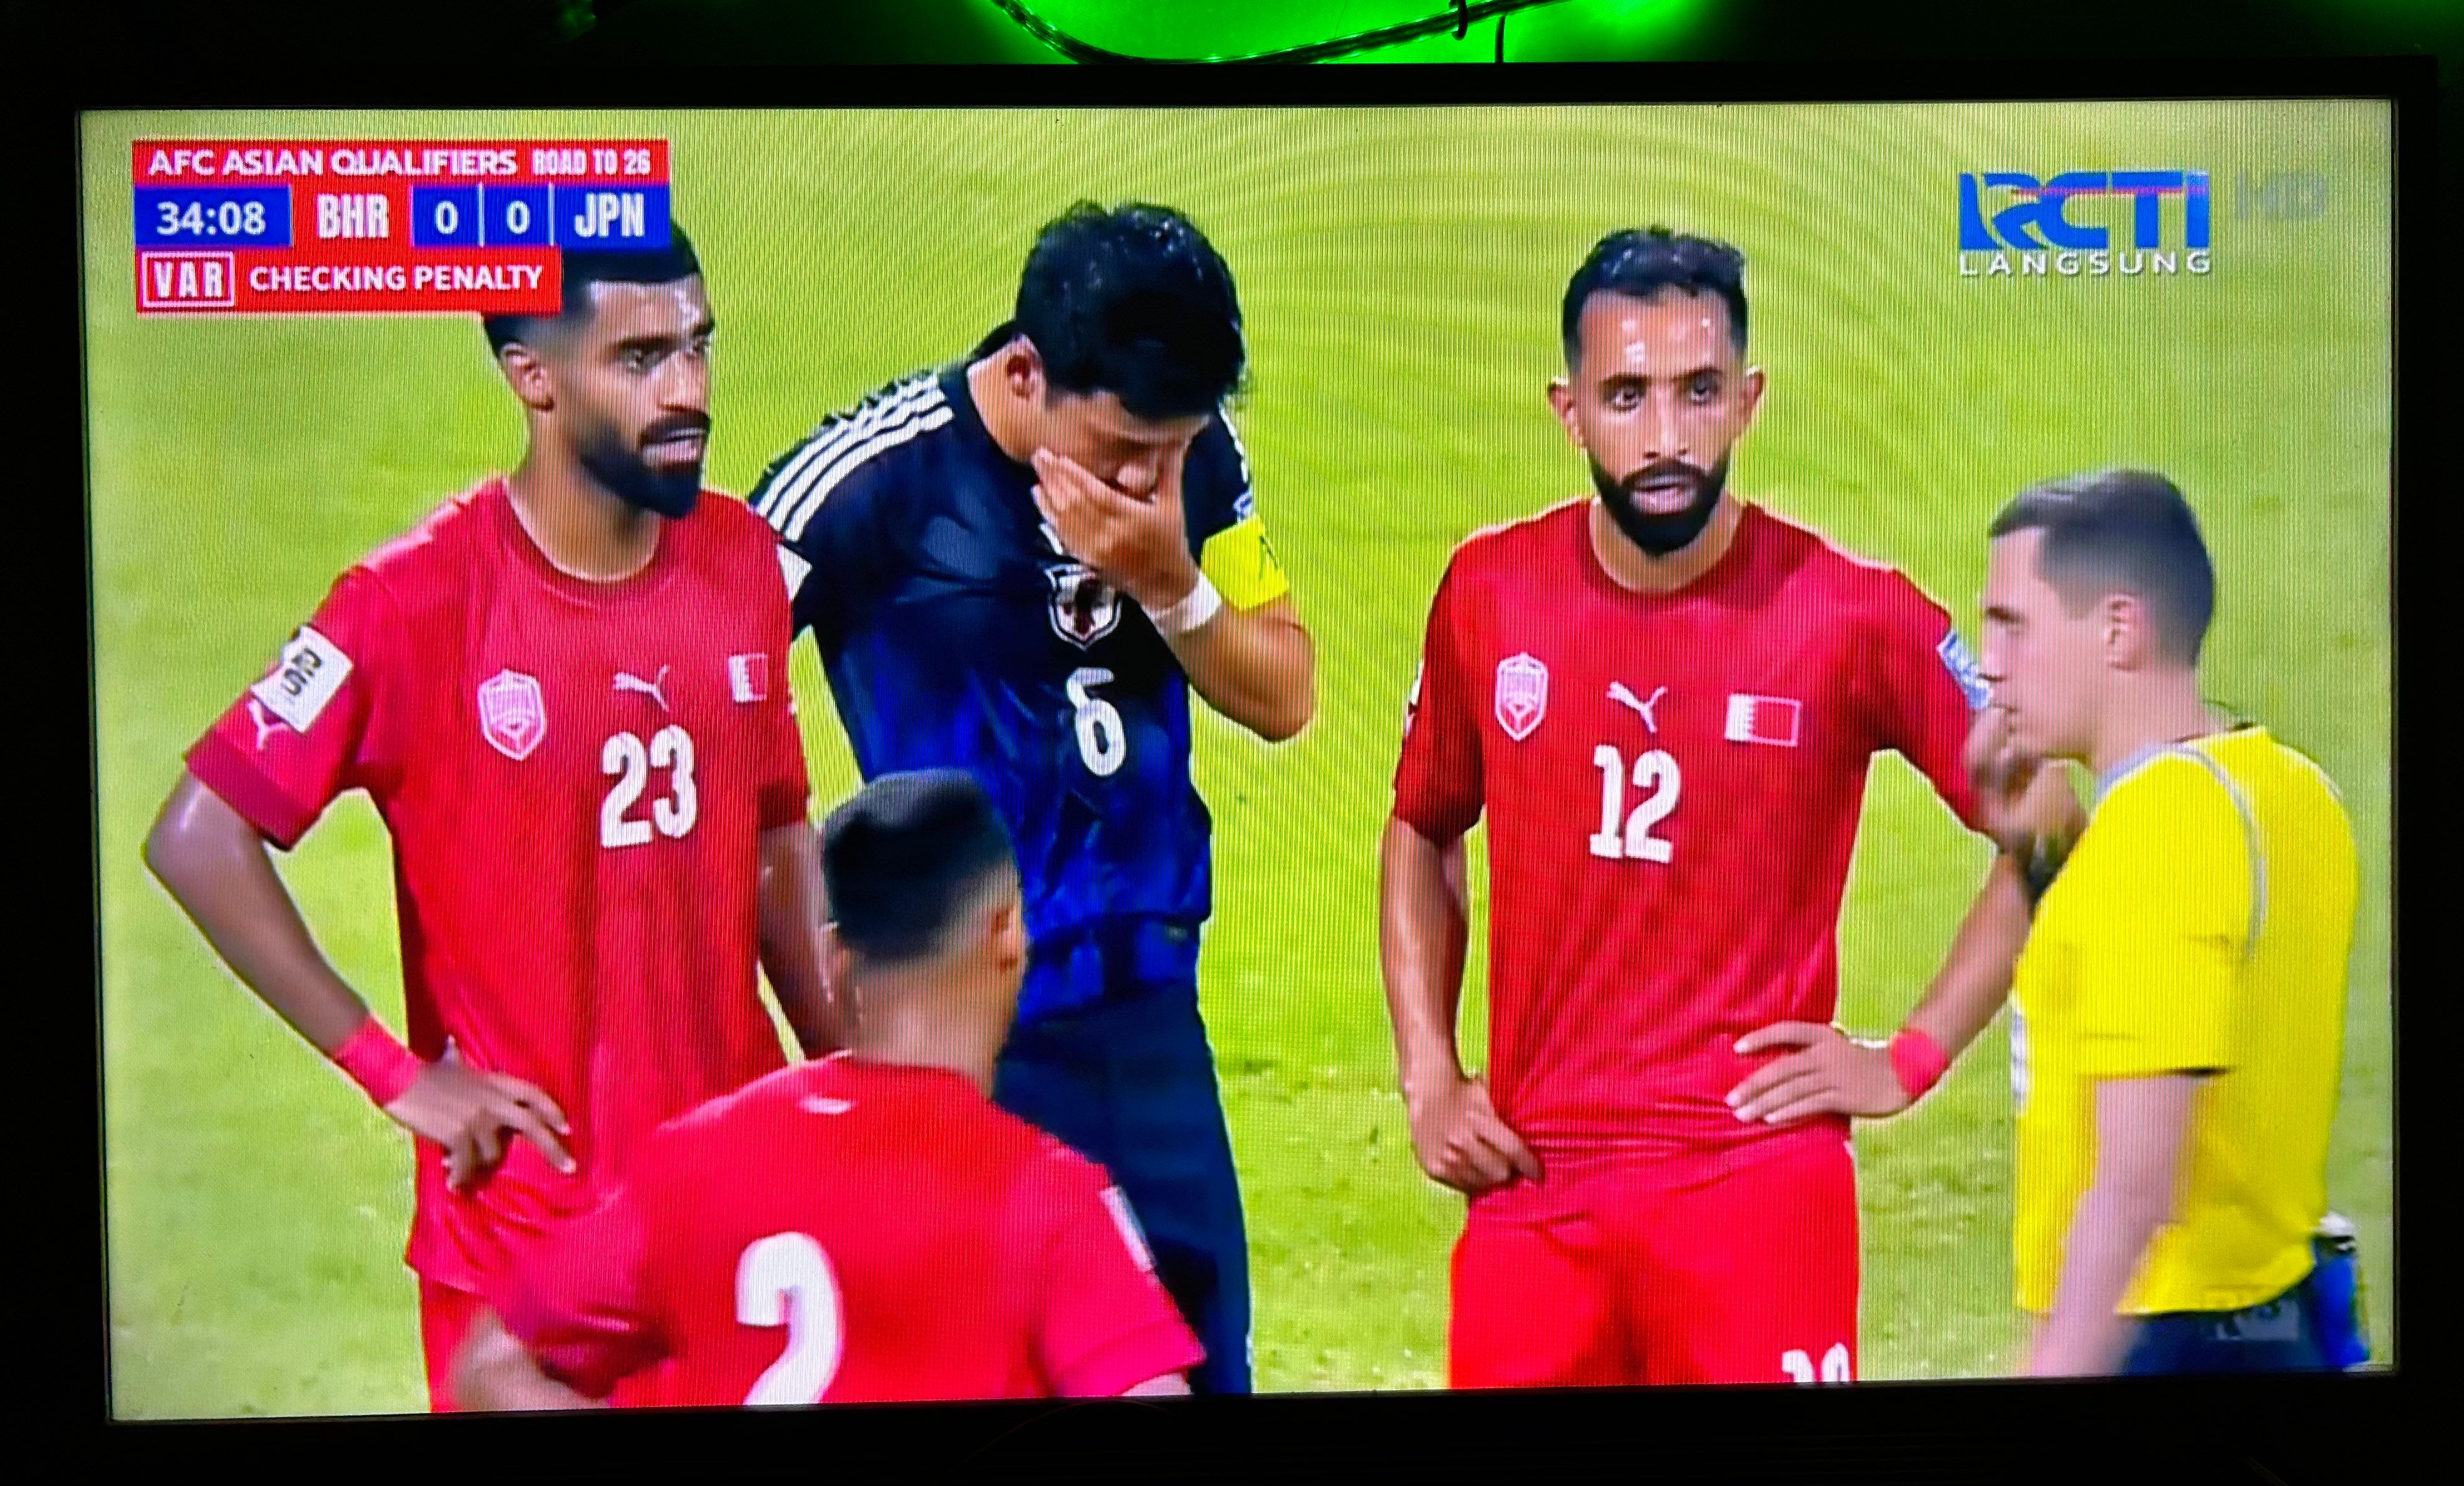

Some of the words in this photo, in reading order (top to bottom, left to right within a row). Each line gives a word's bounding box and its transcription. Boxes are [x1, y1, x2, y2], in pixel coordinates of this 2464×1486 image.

[149, 149, 214, 176] AFC
[222, 149, 323, 175] ASIAN
[330, 149, 518, 176] QUALIFIERS
[532, 148, 586, 175] ROAD
[592, 149, 615, 174] TO
[624, 148, 652, 174] 26
[155, 201, 266, 236] 34:08
[317, 193, 389, 239] BHR
[435, 201, 458, 234] 0
[506, 200, 531, 234] 0
[575, 192, 645, 238] JPN
[1959, 170, 2210, 249] RCTI
[154, 261, 224, 298] VAR
[249, 265, 406, 292] CHECKING
[414, 264, 543, 291] PENALTY
[1960, 250, 2212, 276] LANGSUNG
[1067, 667, 1126, 777] 6
[601, 725, 697, 848] 23
[1590, 744, 1681, 864] 12
